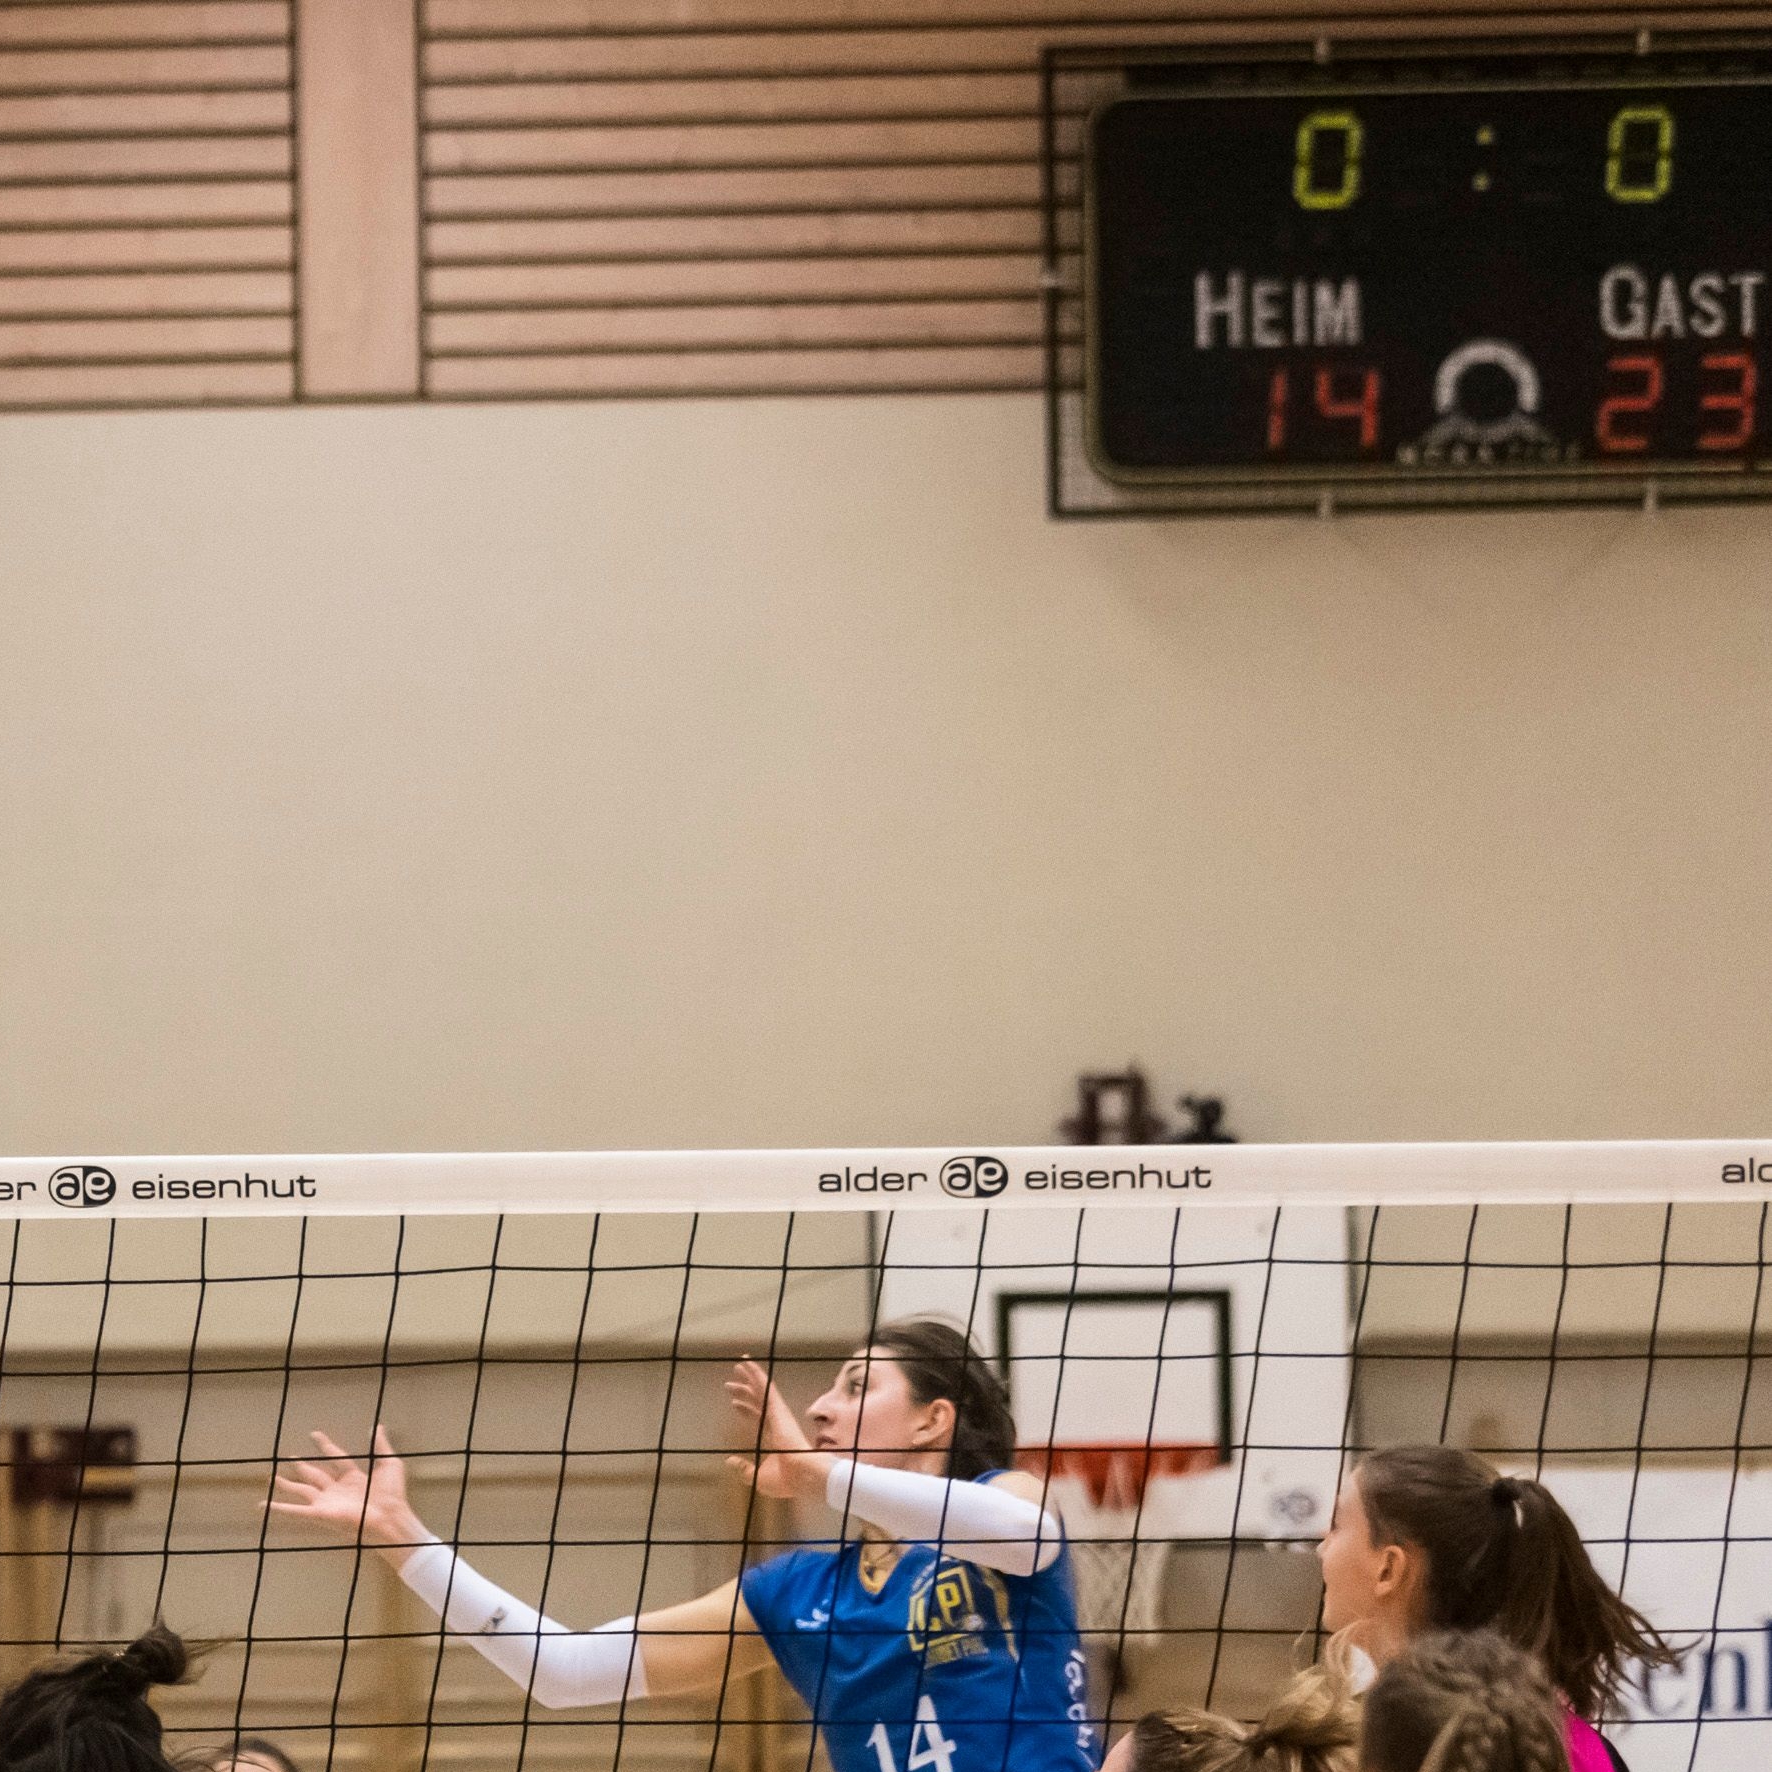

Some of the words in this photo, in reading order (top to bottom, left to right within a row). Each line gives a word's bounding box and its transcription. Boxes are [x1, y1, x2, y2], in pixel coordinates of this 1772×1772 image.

[1294, 111, 1362, 209] 0
[1605, 106, 1673, 202] 0
[1267, 365, 1380, 451] 14
[1595, 351, 1757, 452] 23
[132, 1172, 316, 1199] eisenhut
[818, 1166, 928, 1193] alder
[1024, 1164, 1212, 1190] eisenhut
